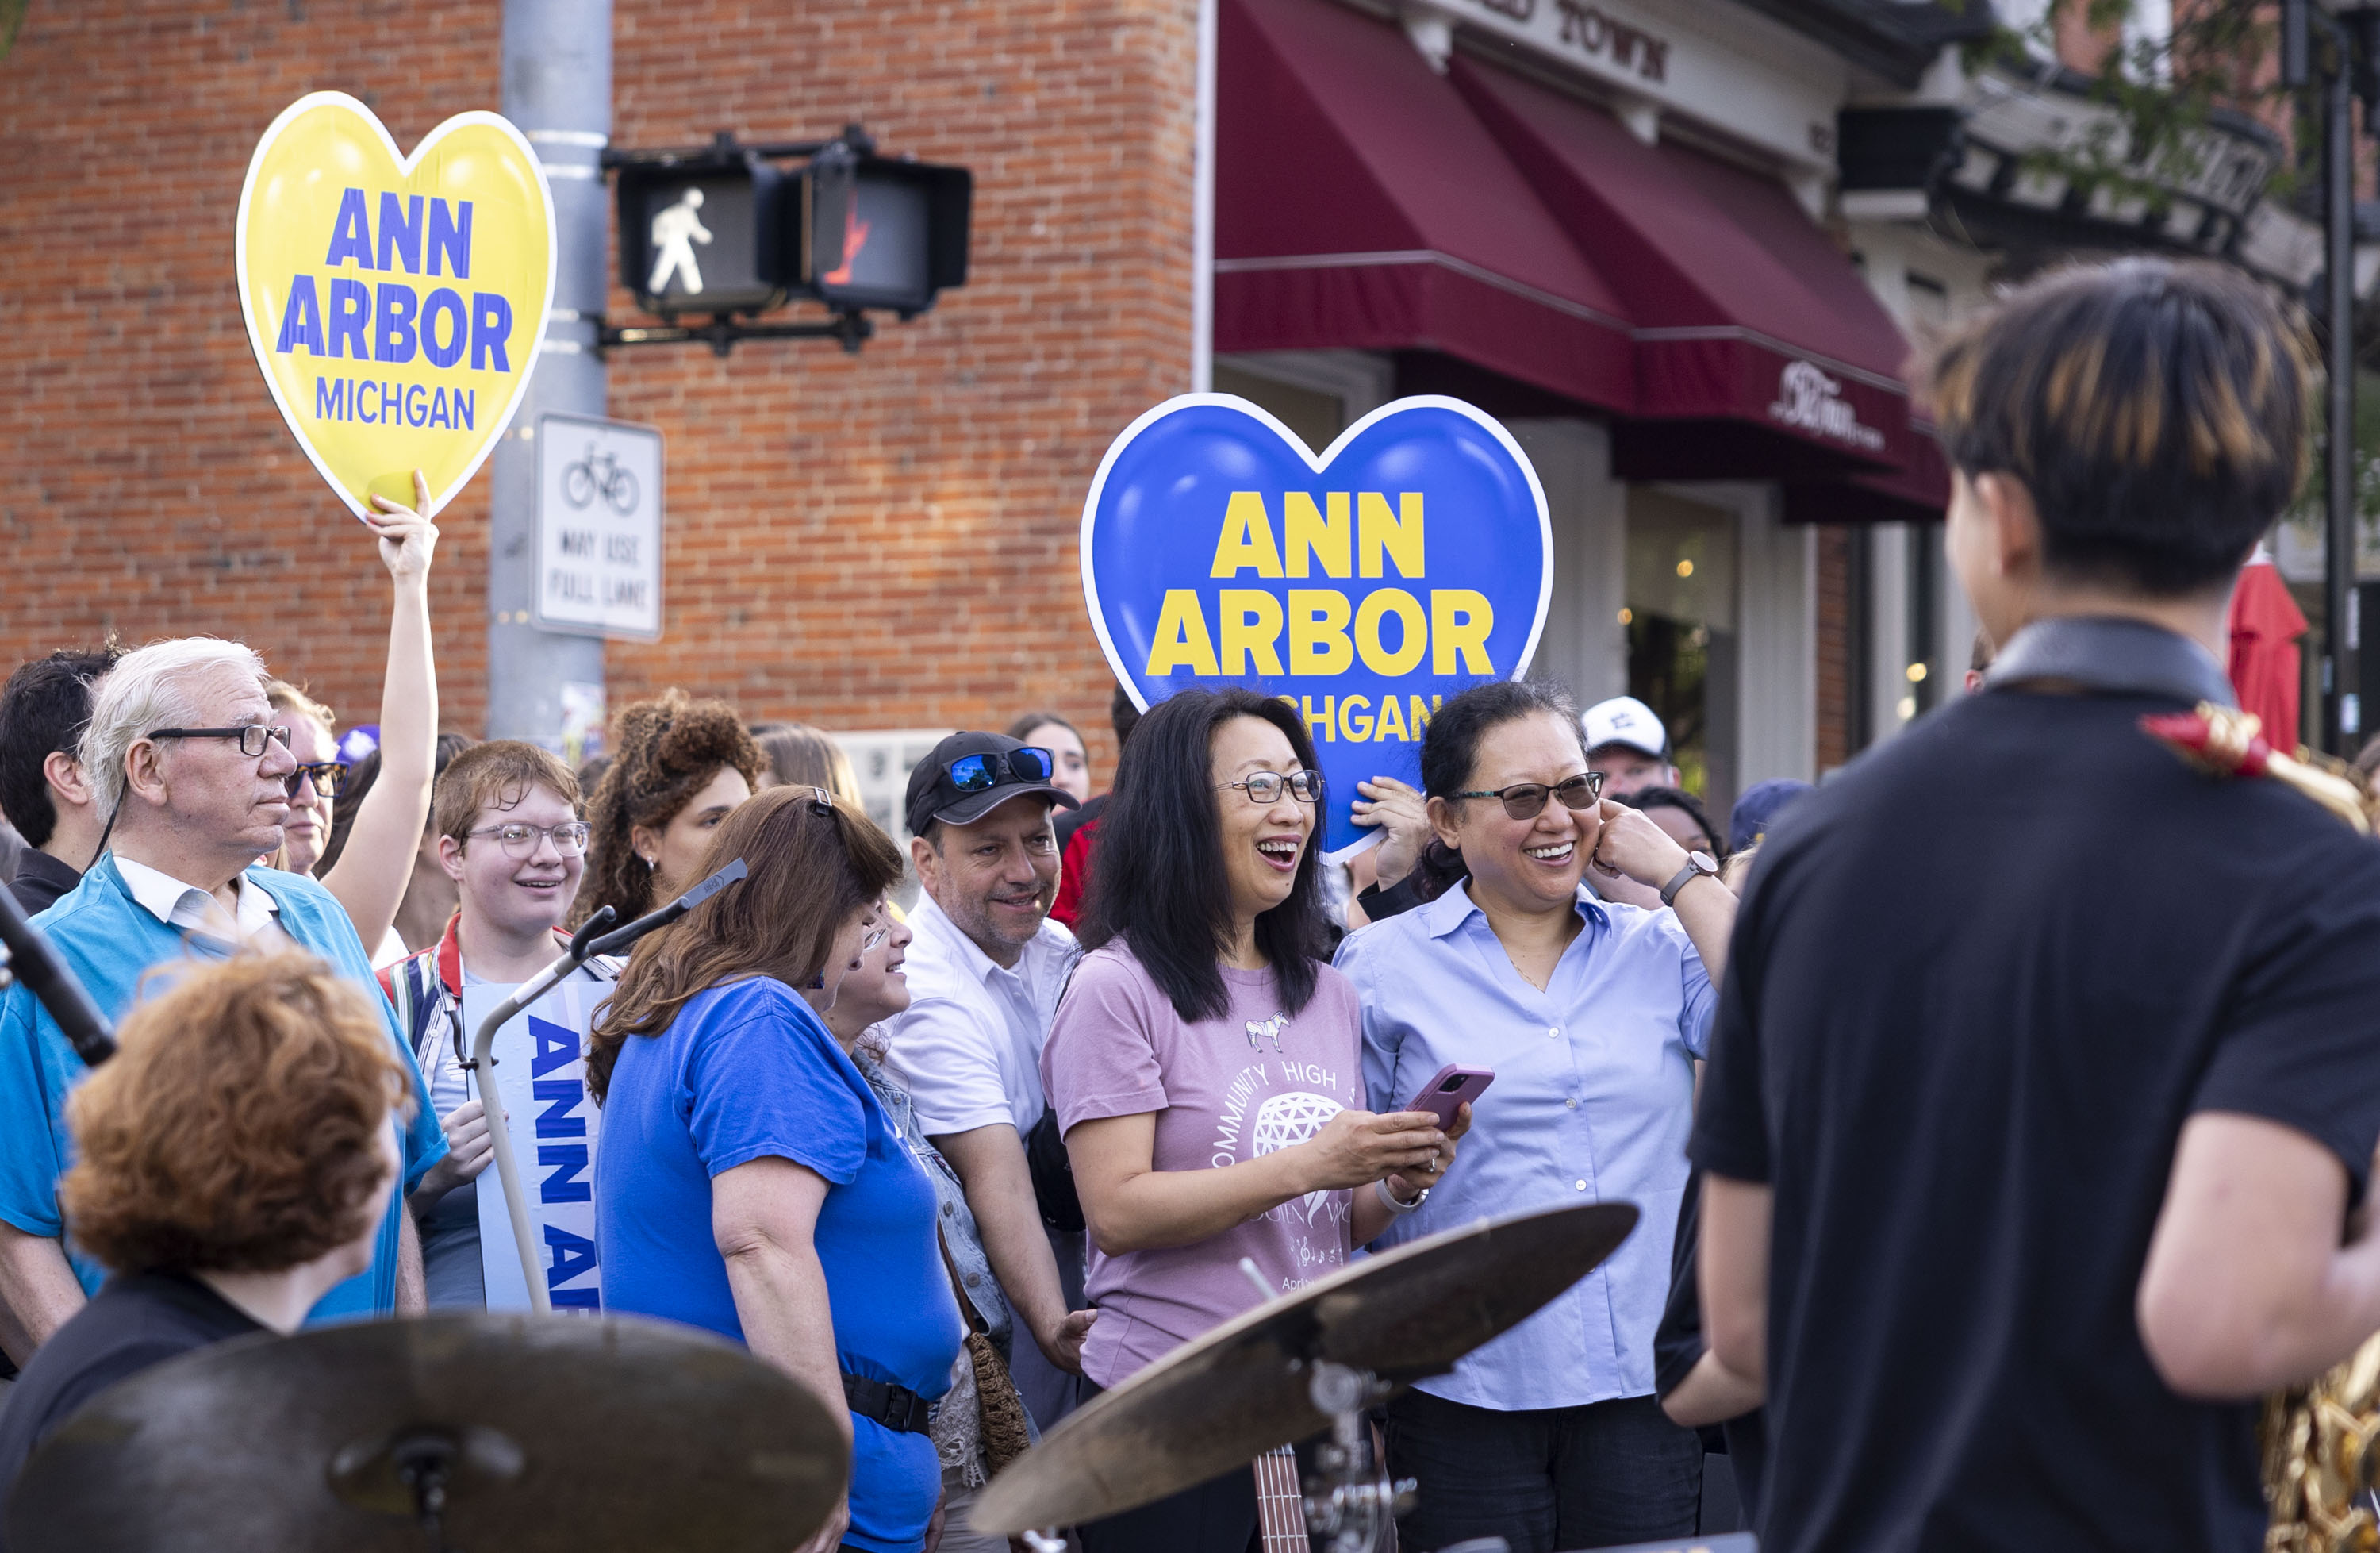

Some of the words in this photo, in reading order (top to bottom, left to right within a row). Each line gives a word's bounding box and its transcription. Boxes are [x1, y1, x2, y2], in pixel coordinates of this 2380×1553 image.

[1557, 0, 1668, 81] TOWN
[325, 187, 474, 280] ANN
[275, 274, 513, 374] ARBOR
[315, 376, 475, 432] MICHGAN
[558, 529, 596, 557] MAY
[603, 532, 641, 567] USE
[1210, 491, 1425, 579] ANN
[548, 567, 593, 602] FULL
[601, 575, 647, 609] LANE
[1145, 588, 1495, 676] ARBOR
[1273, 694, 1443, 743] HGAN
[528, 1014, 592, 1205] ANN
[1211, 1063, 1269, 1168] OMMUNITY
[1281, 1060, 1336, 1090] HIGH
